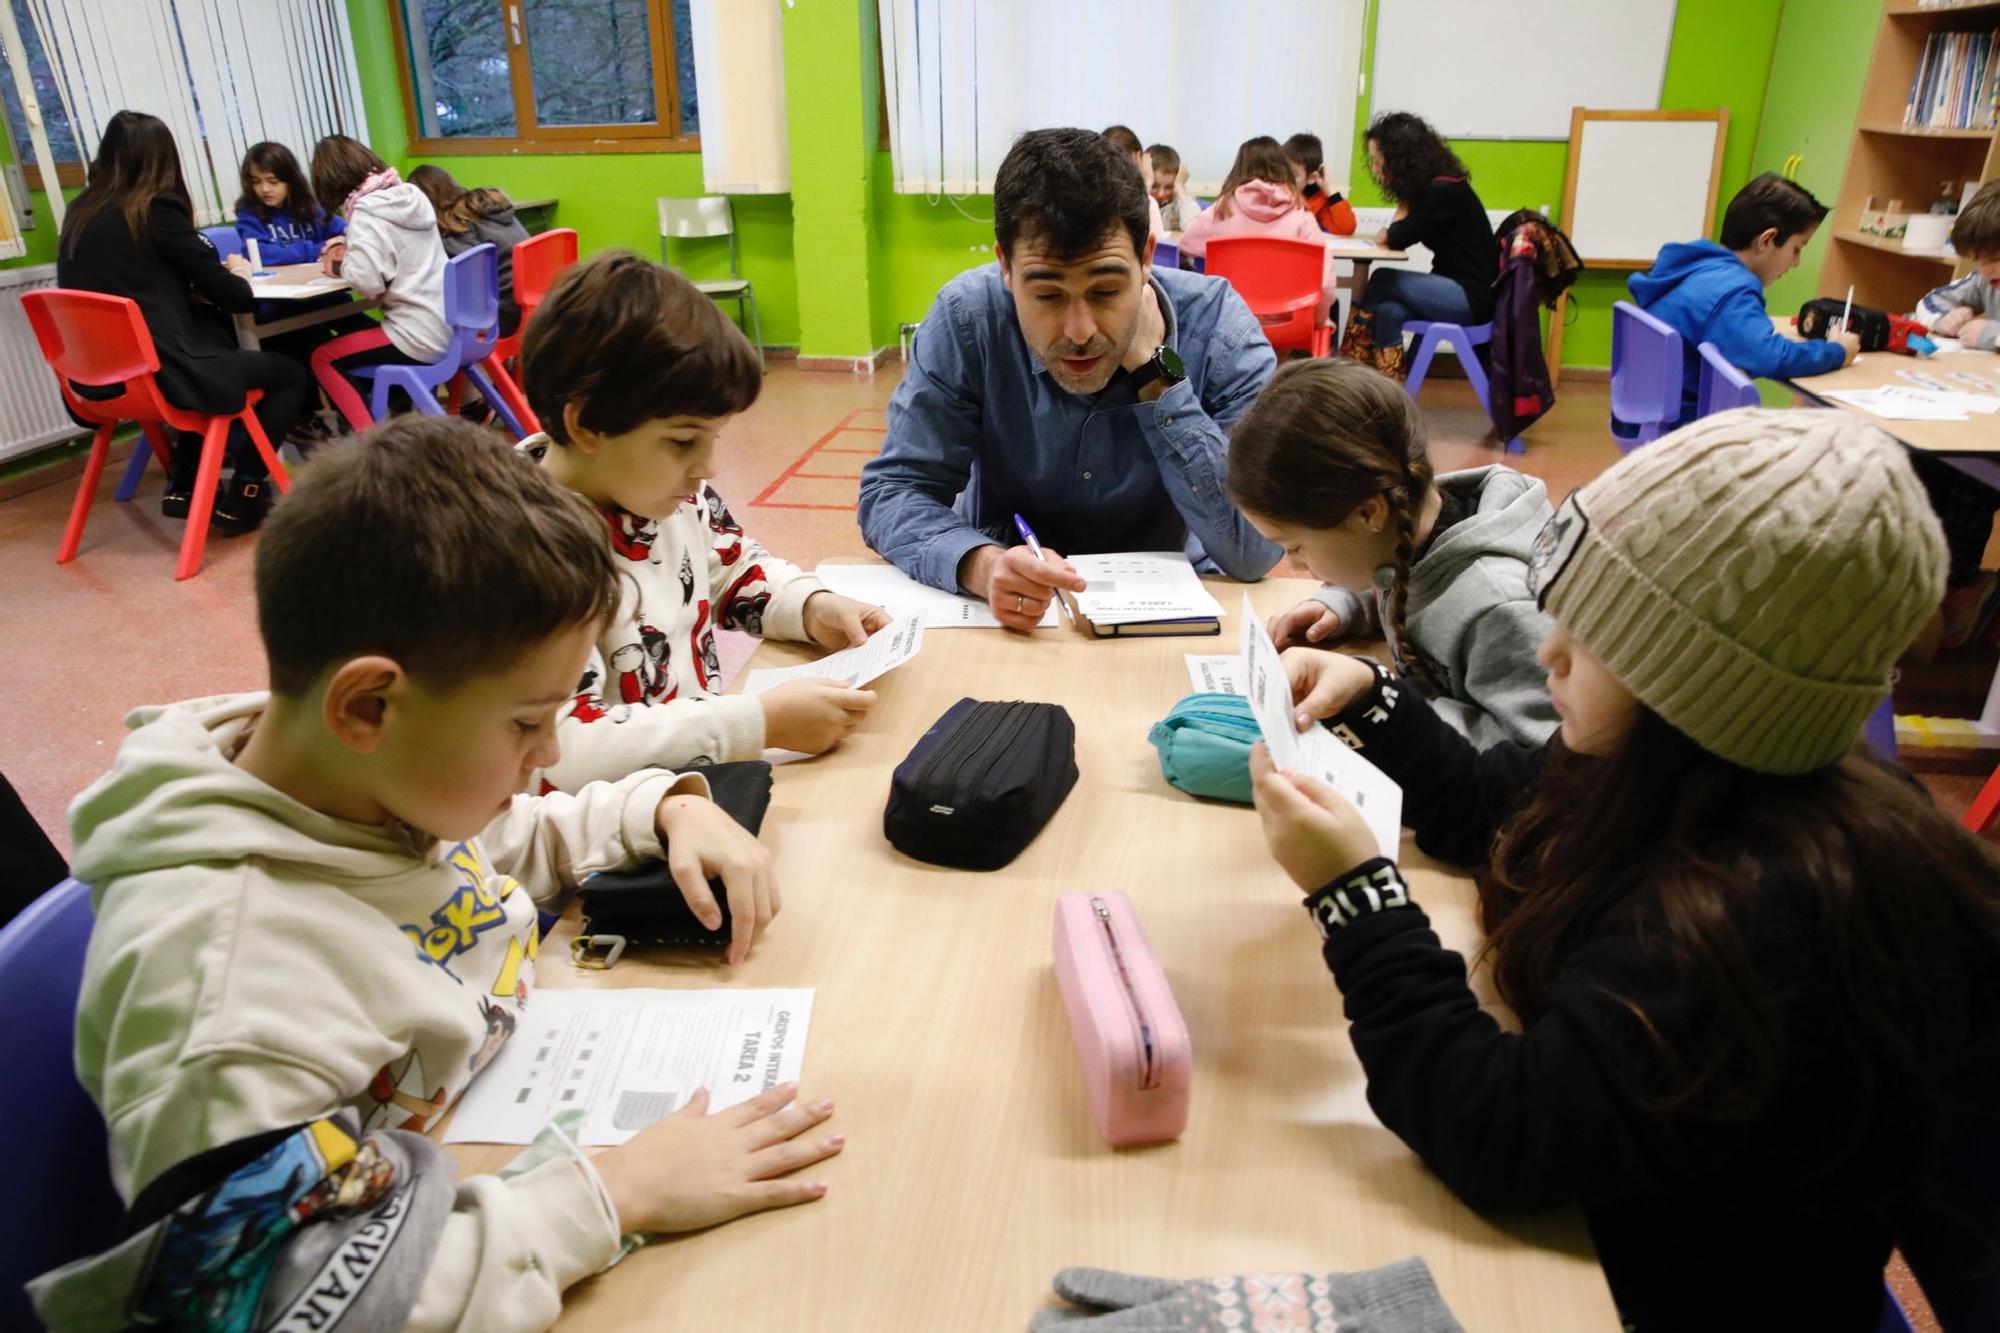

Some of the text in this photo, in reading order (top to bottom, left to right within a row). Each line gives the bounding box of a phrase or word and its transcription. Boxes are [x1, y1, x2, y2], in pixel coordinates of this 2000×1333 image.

[733, 1031, 762, 1083] TAREA 2
[762, 1010, 791, 1092] GRUPOS INTERA
